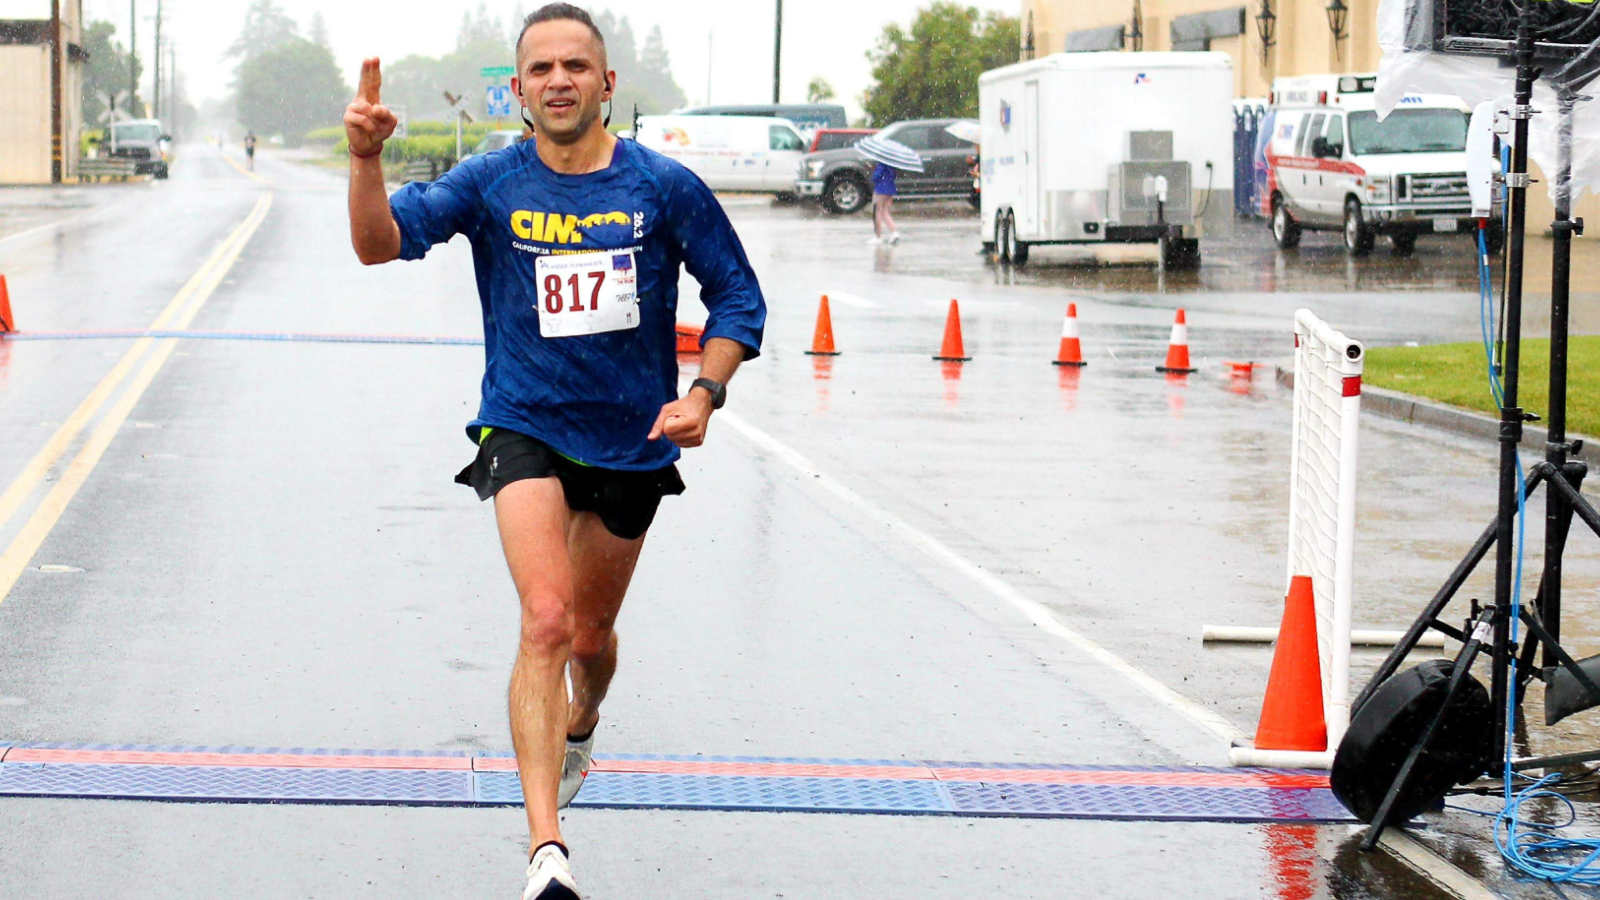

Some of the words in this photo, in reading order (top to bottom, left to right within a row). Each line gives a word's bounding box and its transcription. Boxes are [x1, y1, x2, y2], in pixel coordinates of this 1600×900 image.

[510, 210, 582, 244] CIM
[633, 211, 644, 239] 26.2
[544, 271, 605, 314] 817
